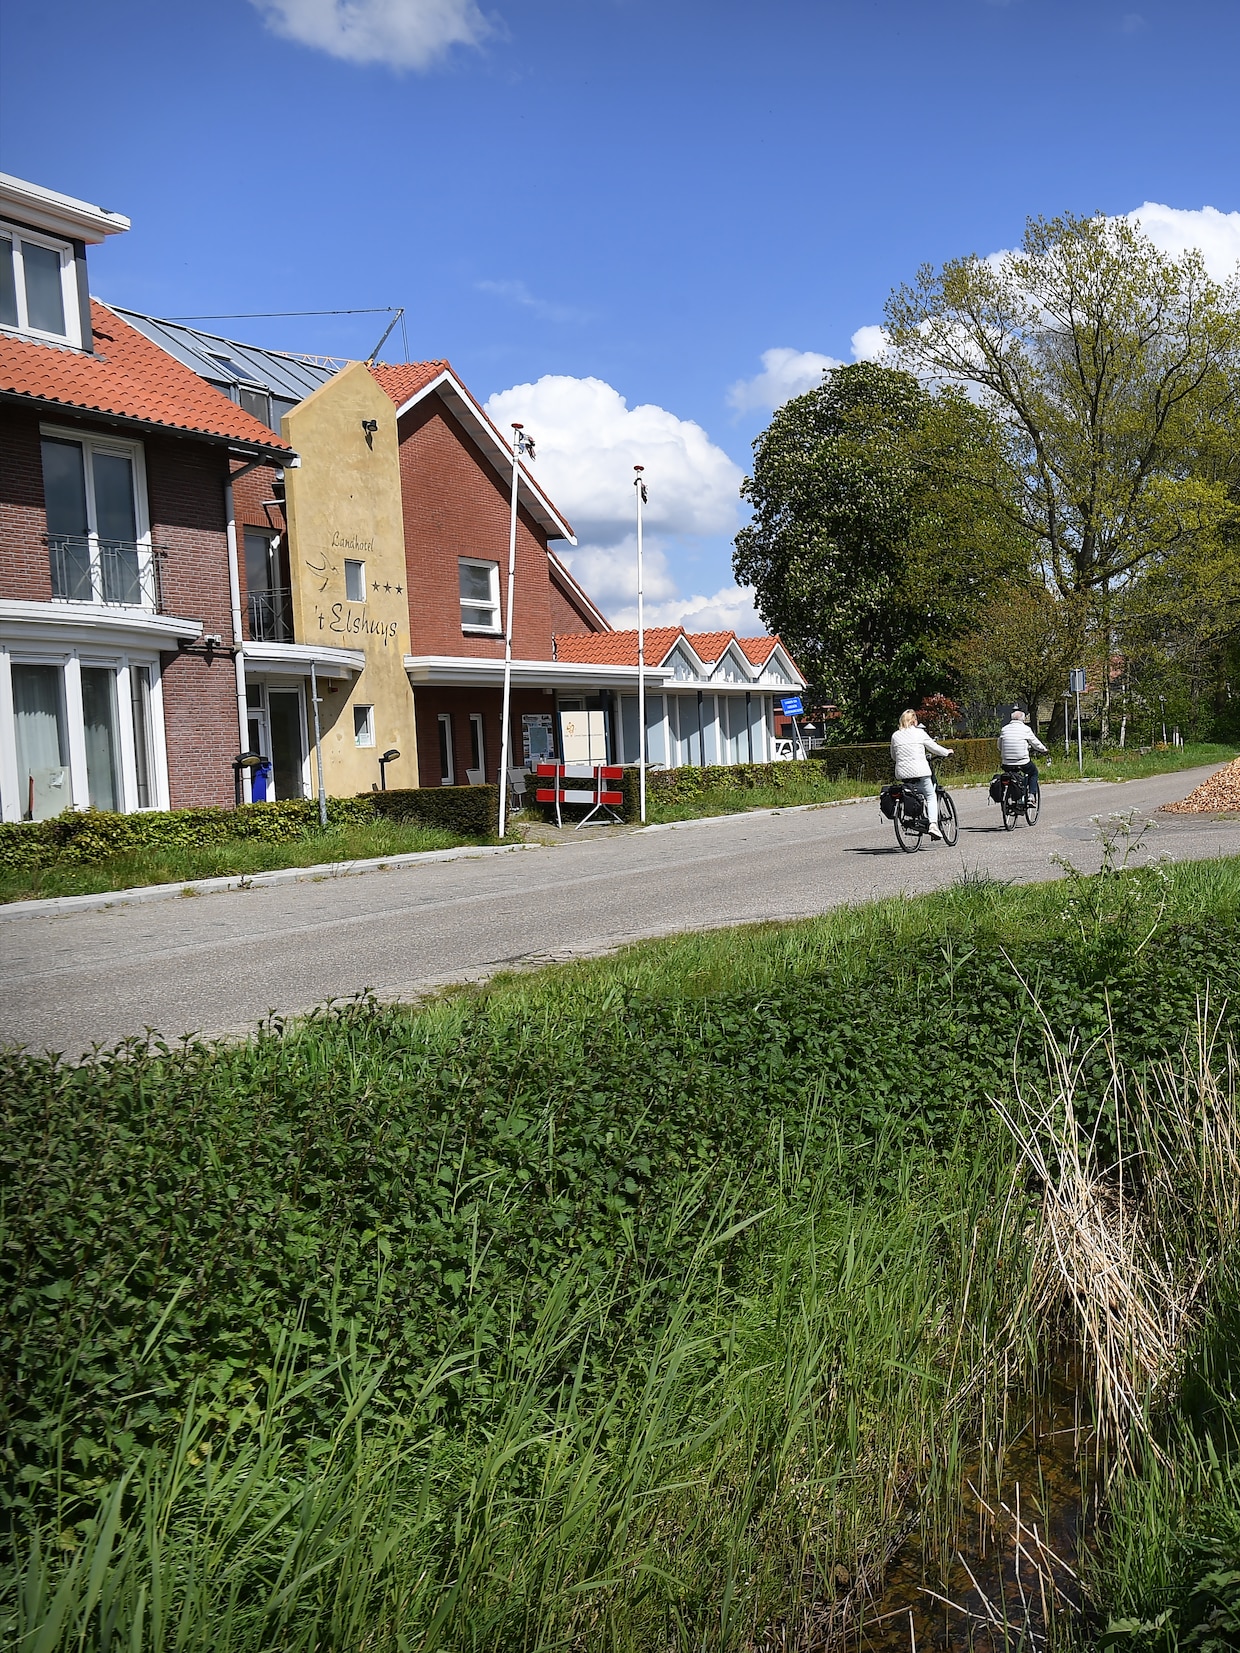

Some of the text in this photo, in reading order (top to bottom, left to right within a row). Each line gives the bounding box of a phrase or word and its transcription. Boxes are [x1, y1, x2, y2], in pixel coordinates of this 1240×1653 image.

[331, 530, 374, 552] Landhotel
[315, 603, 398, 646] 't Elshuys
